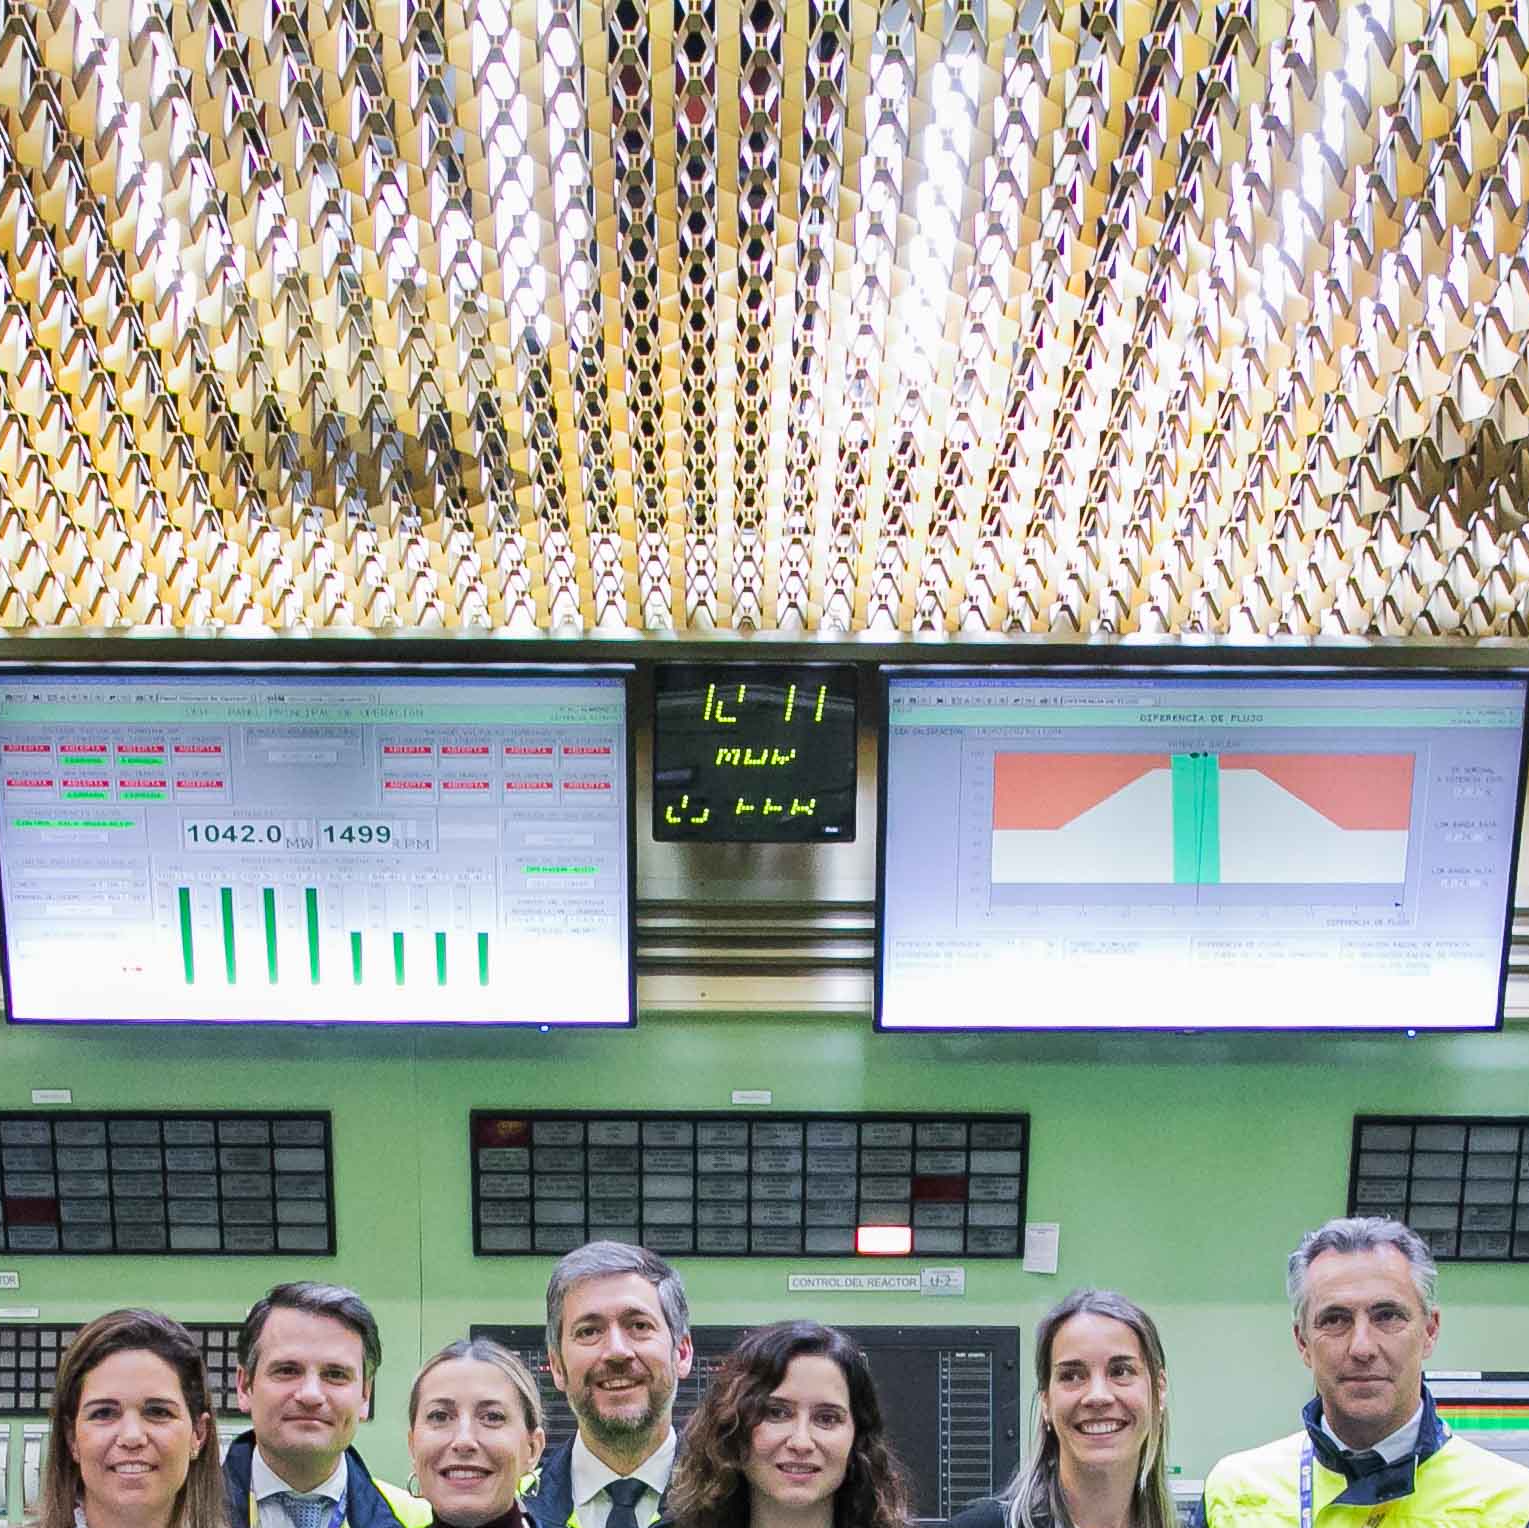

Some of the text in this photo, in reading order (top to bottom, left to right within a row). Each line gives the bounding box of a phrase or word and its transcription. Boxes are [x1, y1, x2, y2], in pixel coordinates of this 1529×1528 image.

[1140, 713, 1264, 723] DIFERENCIA DE FLUJO
[187, 824, 282, 843] 1042.0
[323, 824, 392, 844] 1499
[285, 837, 314, 849] MW
[392, 838, 431, 849] RPM
[792, 1278, 917, 1288] CONTROL DEL REACTOR
